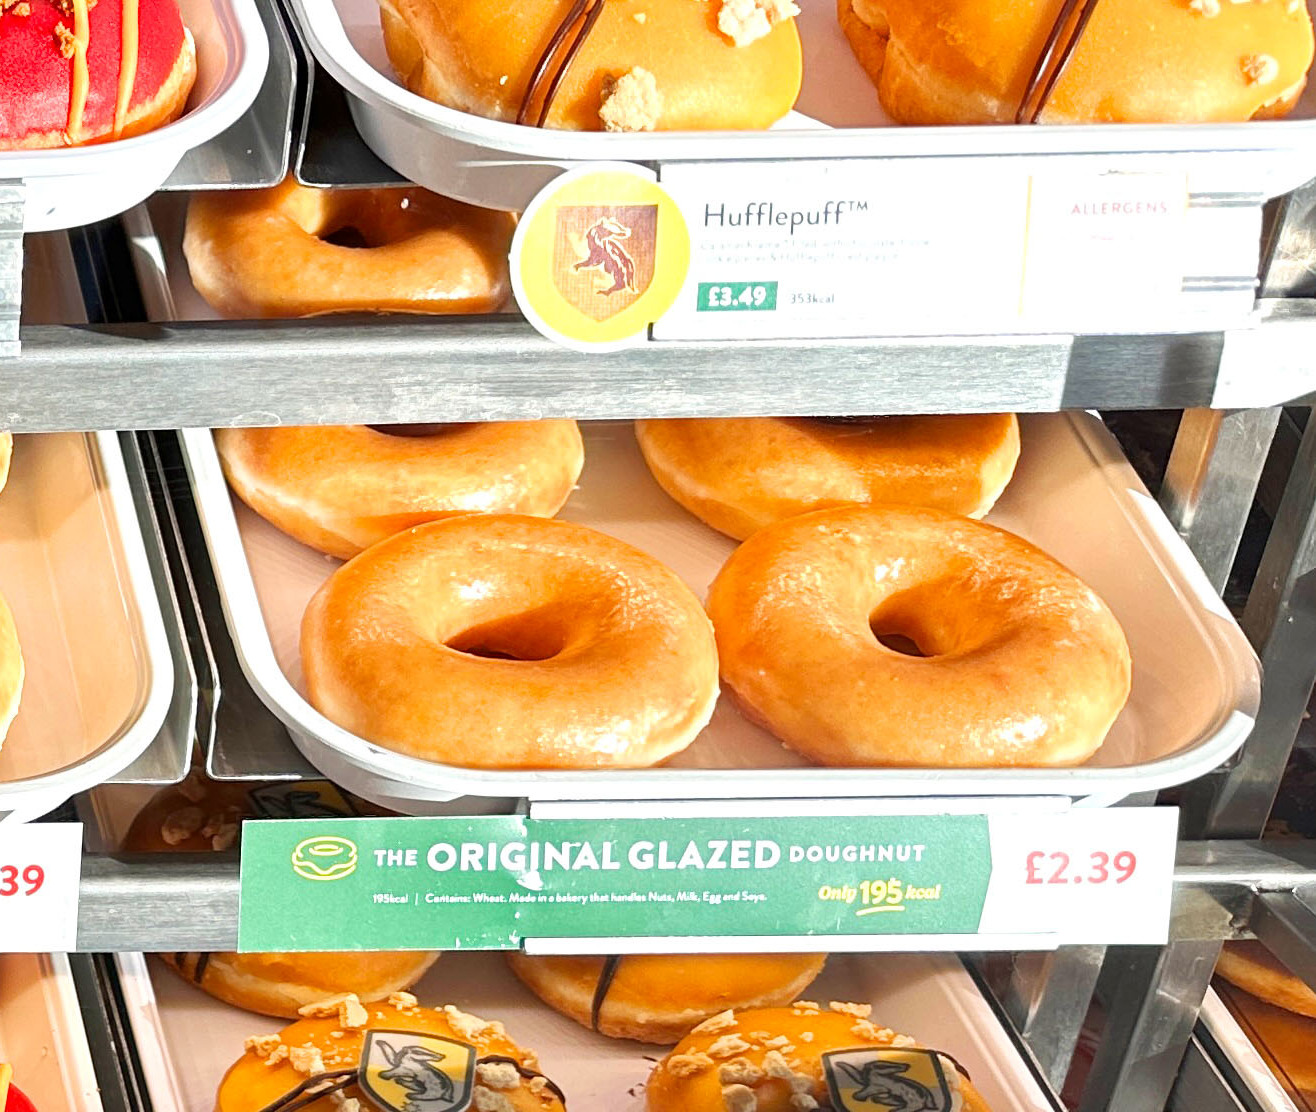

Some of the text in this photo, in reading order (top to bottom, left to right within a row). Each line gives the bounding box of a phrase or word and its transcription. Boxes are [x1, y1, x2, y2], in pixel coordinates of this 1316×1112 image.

[1071, 201, 1168, 215] ALLERGENS
[708, 285, 767, 307] £3.49
[790, 293, 835, 304] 353kcal
[373, 840, 926, 872] THE ORIGINAL GLAZED DOUGHNUT
[1025, 850, 1137, 884] £2.39
[818, 879, 941, 905] Only 195 kcal
